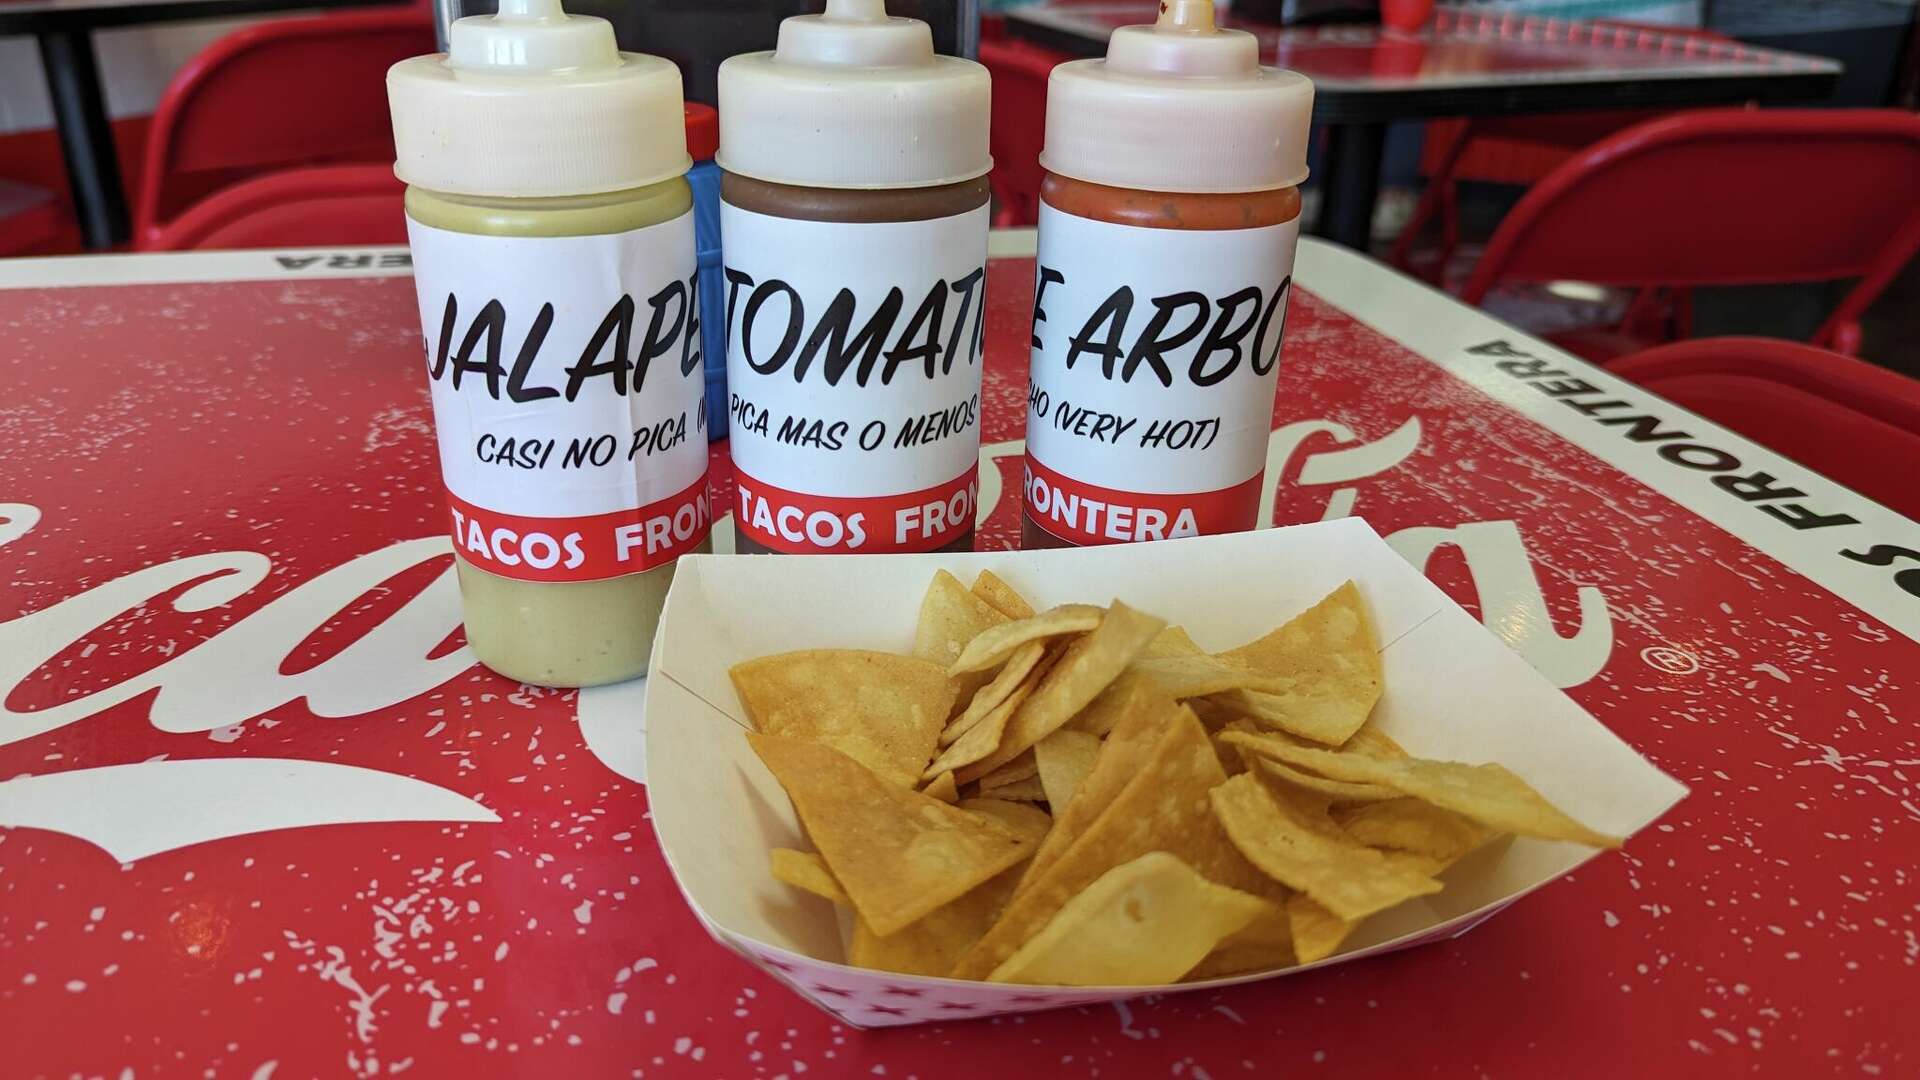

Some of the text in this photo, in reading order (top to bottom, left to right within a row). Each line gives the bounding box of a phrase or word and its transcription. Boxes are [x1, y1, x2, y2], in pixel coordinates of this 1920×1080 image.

[476, 433, 555, 470] CASI
[562, 434, 617, 470] NO
[628, 411, 687, 462] PICA
[731, 392, 978, 452] PICA MAS O MENOS
[1054, 400, 1138, 445] (VERY
[1140, 416, 1222, 451] HOT)
[1464, 339, 1863, 531] FRONTERA
[450, 505, 586, 570] TACOS
[737, 483, 867, 550] TACOS
